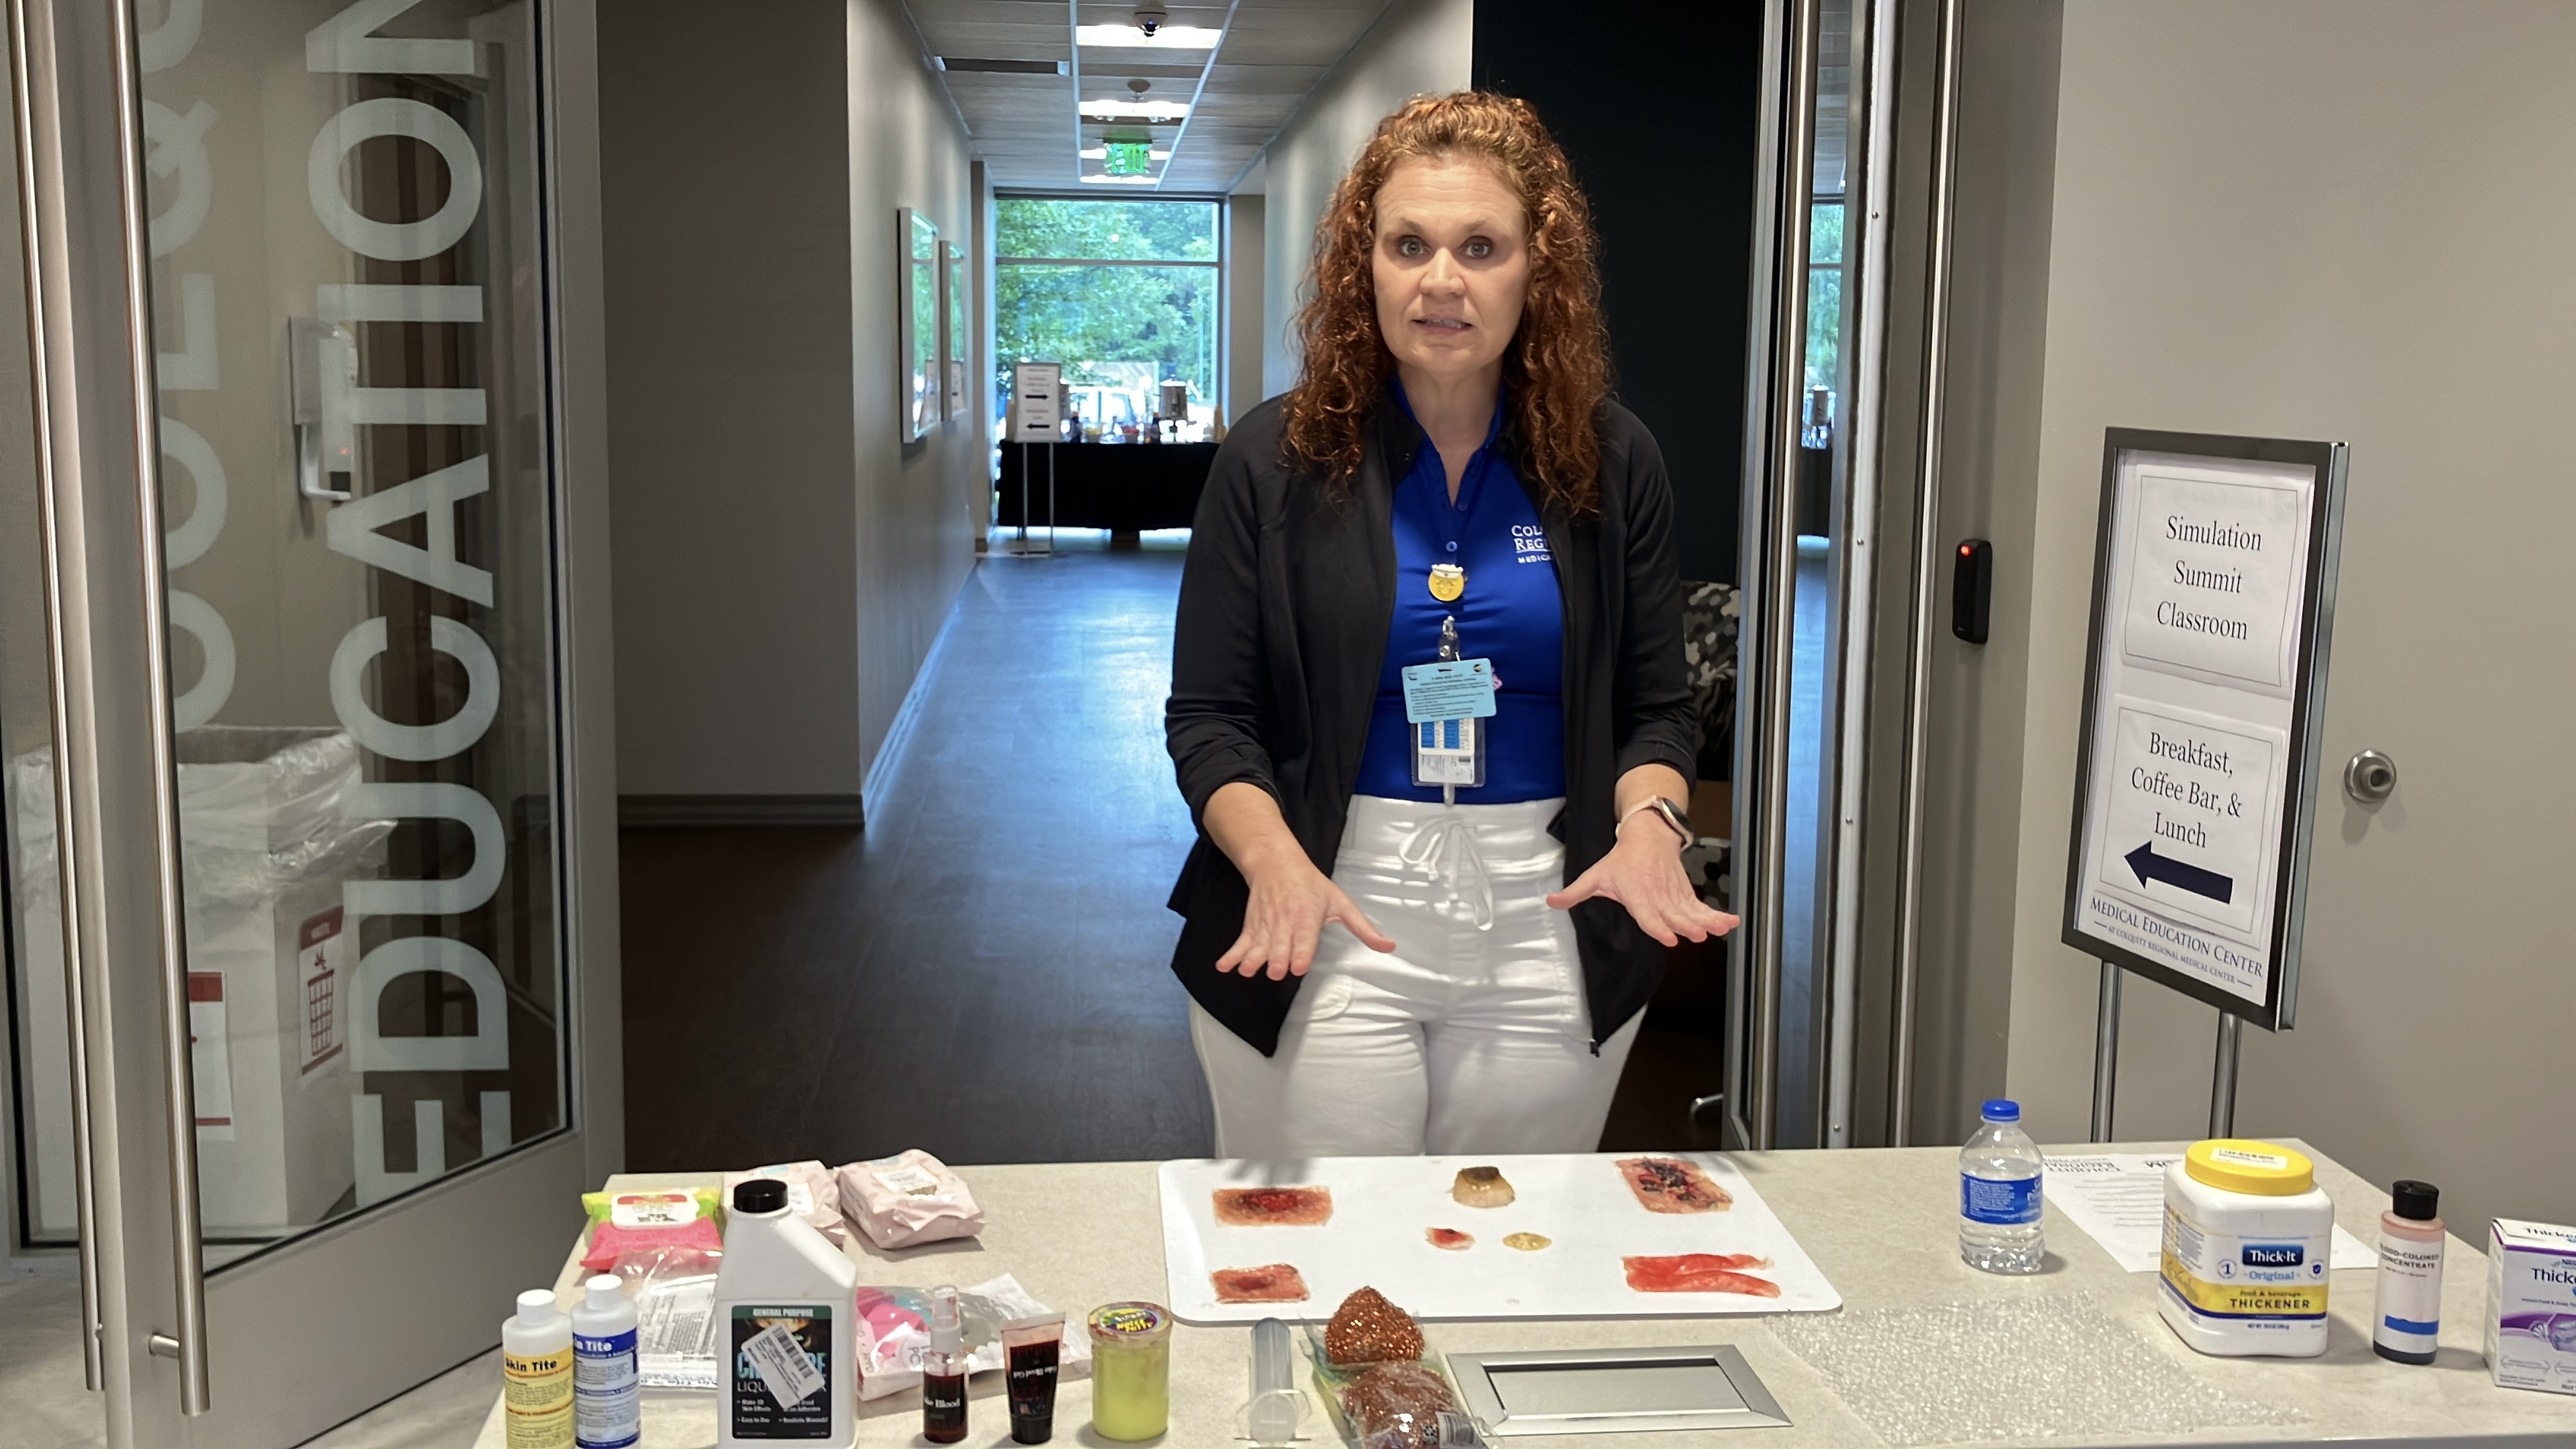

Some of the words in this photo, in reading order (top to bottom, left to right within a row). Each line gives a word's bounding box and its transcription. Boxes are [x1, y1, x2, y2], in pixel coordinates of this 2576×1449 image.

[1511, 525, 1543, 536] COL
[2165, 514, 2262, 551] Simulation
[1518, 554, 1551, 564] MEDICA
[2174, 560, 2243, 594] Summit
[305, 0, 512, 1205] EDUCATION
[2157, 601, 2248, 640] Classroom
[2149, 732, 2234, 778] Breakfast,
[2131, 766, 2184, 801] Coffee
[2188, 782, 2222, 816] Bar,
[2228, 793, 2242, 817] &
[2154, 812, 2206, 849] Lunch
[2091, 897, 2139, 929] MEDICAL
[2143, 916, 2210, 956] EDUCATION
[2214, 945, 2263, 978] CENTER
[2249, 1270, 2295, 1282] Original
[2531, 1267, 2576, 1284] Thick
[2230, 1298, 2310, 1309] THICKENER
[585, 1339, 613, 1352] Tite
[506, 1357, 527, 1372] Skin
[532, 1359, 558, 1371] Tite
[737, 1381, 771, 1393] LIQU
